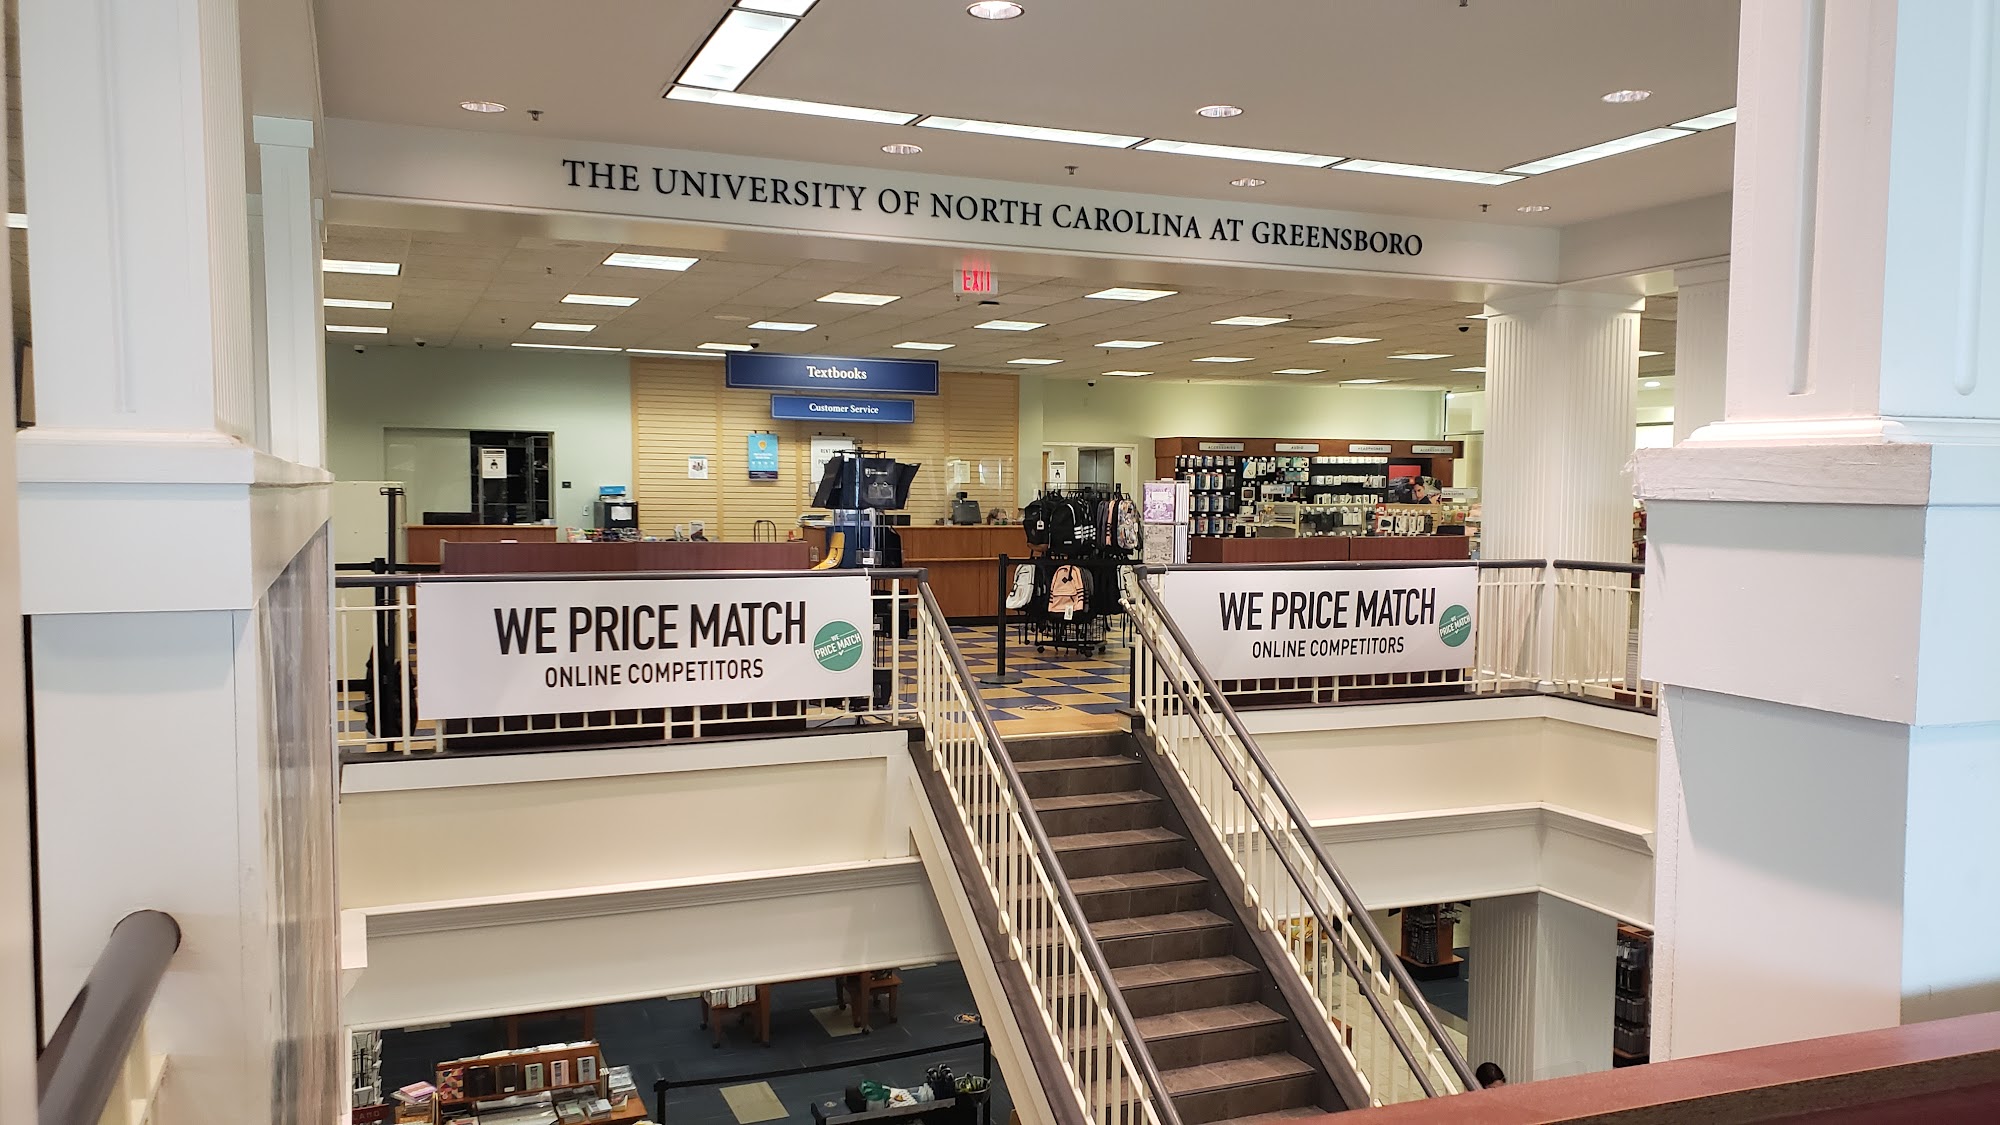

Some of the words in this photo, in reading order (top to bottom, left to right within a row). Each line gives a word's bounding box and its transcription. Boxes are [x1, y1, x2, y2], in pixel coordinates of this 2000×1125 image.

[562, 158, 640, 192] THE
[652, 167, 867, 211] UNIVERSITY
[878, 188, 920, 216] OF
[930, 193, 1042, 227] NORTH
[1052, 204, 1202, 240] CAROLINA
[1209, 218, 1244, 242] AT
[1252, 221, 1423, 256] GREENSBORO
[962, 269, 991, 292] EXIT
[806, 365, 868, 380] Textbooks
[808, 402, 849, 413] Customer
[850, 405, 879, 414] Service
[1219, 591, 1264, 631] WE
[1270, 590, 1350, 630] PRICE
[1355, 587, 1436, 628] MATCH
[493, 606, 557, 655] WE
[569, 604, 679, 653] PRICE
[690, 600, 806, 648] MATCH
[831, 633, 840, 641] WE
[1439, 623, 1455, 637] PRICE
[1454, 614, 1471, 629] MATCH
[815, 643, 837, 659] PRICE
[837, 632, 861, 650] MATCH
[1252, 639, 1307, 659] ONLINE
[1310, 636, 1405, 657] COMPETITORS
[545, 664, 621, 688] ONLINE
[628, 658, 764, 683] COMPETITORS
